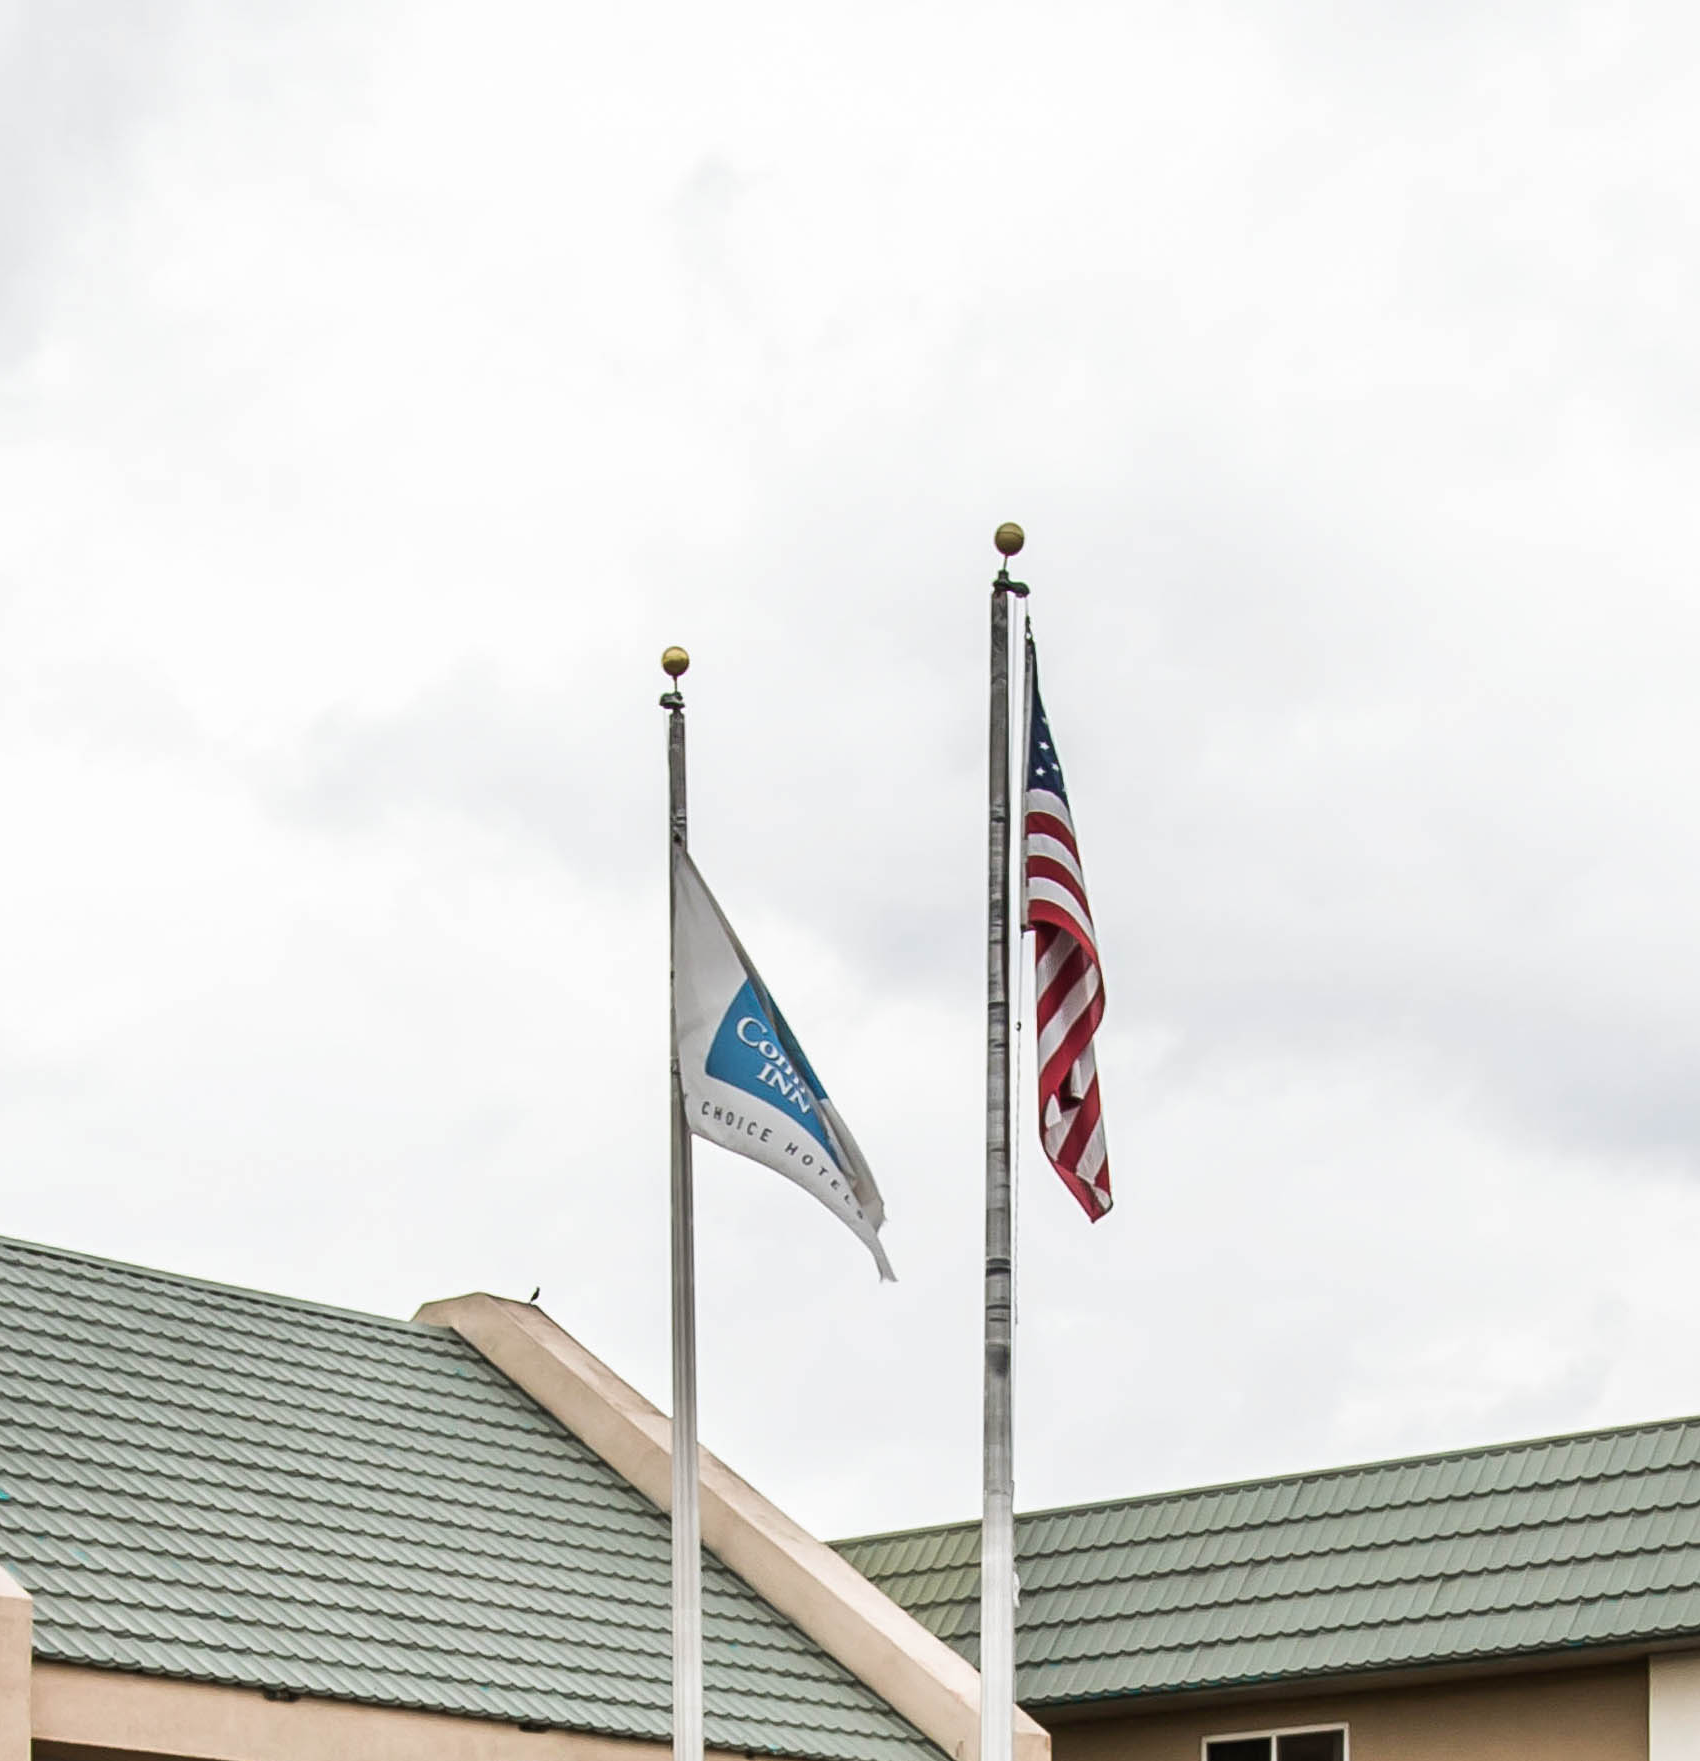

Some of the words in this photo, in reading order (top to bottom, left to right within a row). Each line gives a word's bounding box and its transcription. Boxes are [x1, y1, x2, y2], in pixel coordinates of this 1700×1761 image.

[756, 1062, 811, 1113] INN
[701, 1101, 772, 1142] CHOICE
[785, 1142, 863, 1220] HOTELS
